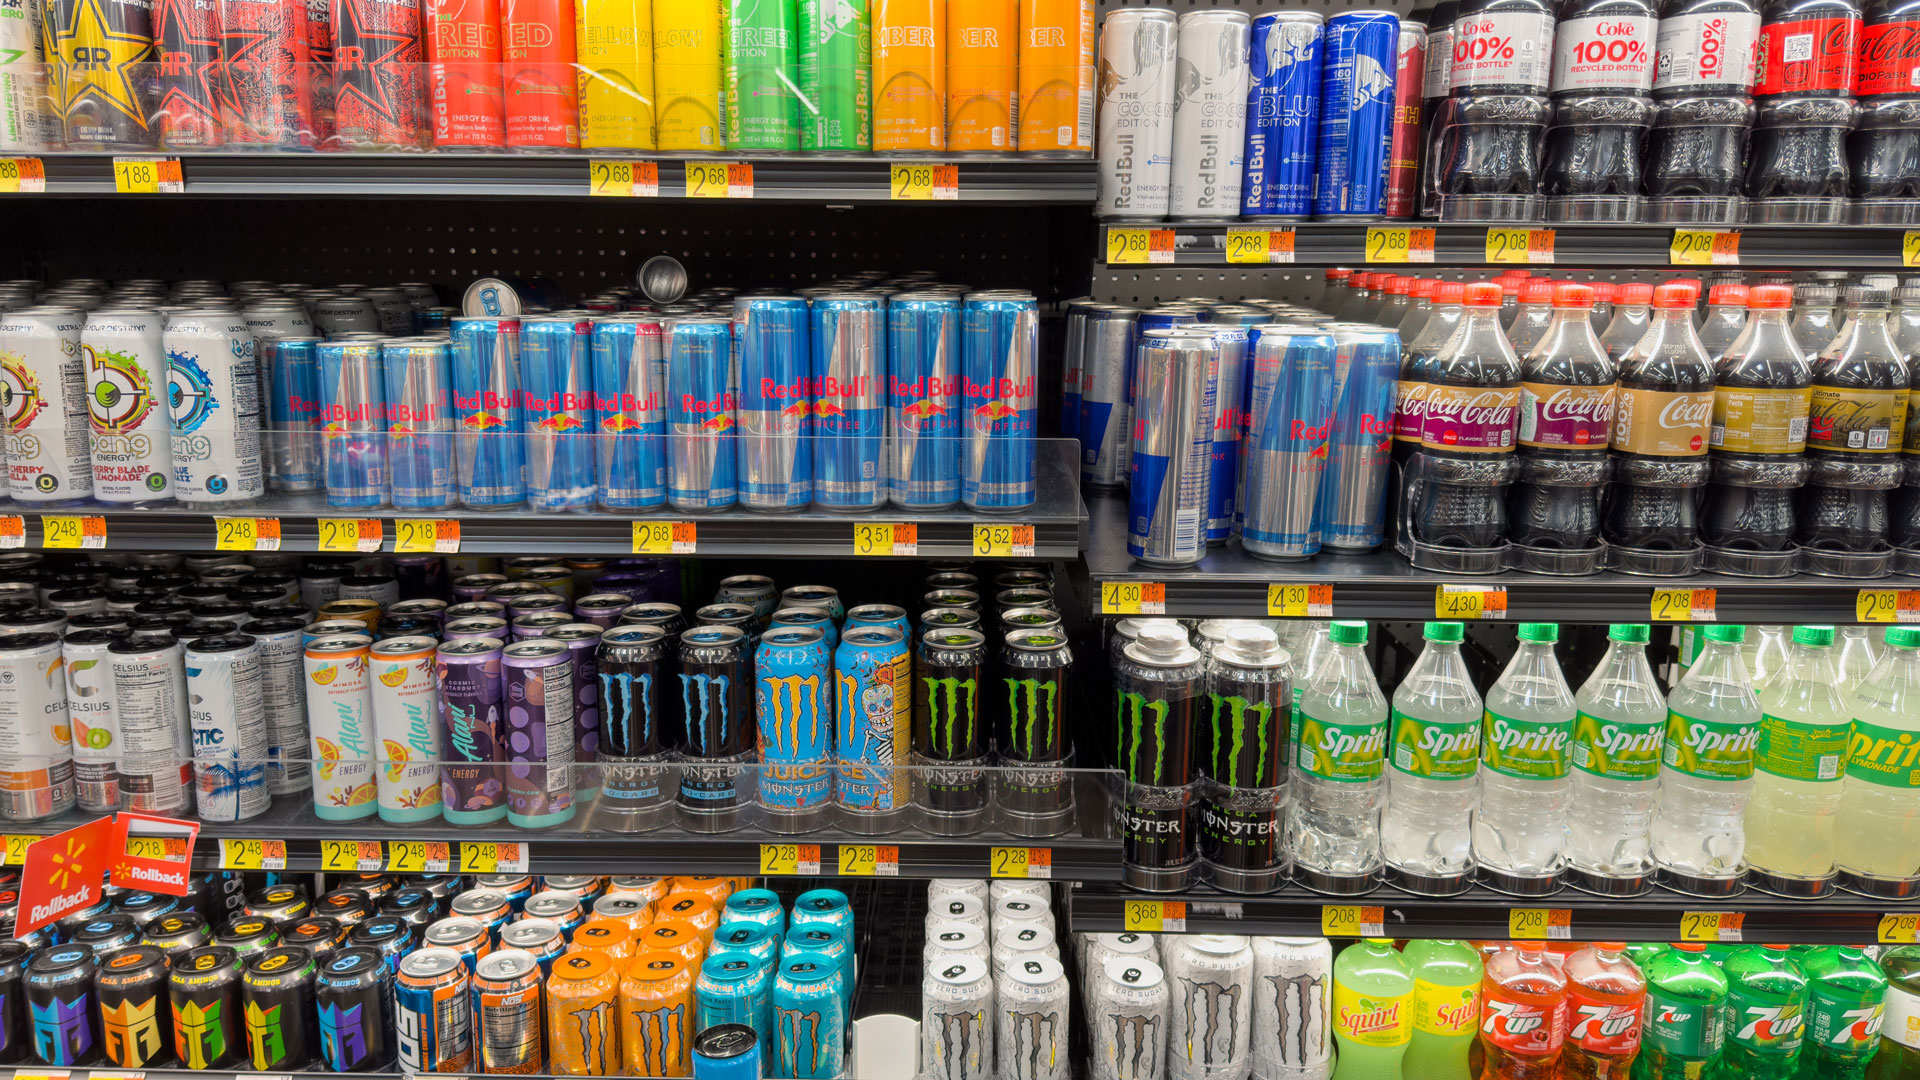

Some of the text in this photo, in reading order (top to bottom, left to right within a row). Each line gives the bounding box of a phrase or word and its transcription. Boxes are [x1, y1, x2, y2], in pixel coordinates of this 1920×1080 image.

[436, 23, 500, 49] RED
[1463, 21, 1494, 36] Coke
[1596, 21, 1635, 36] Coke
[728, 28, 793, 51] GREEN
[873, 27, 935, 47] MBER
[437, 49, 479, 58] EDITION
[729, 48, 766, 58] EDITION
[1453, 37, 1514, 64] 100%
[1573, 39, 1647, 64] 100%
[1699, 18, 1722, 79] 100%
[1333, 69, 1351, 78] 160
[1571, 63, 1614, 74] RECYCLED
[433, 64, 447, 100] Bull
[727, 66, 738, 103] Bull
[856, 69, 868, 105] Bull
[1259, 87, 1278, 95] THE
[1258, 95, 1319, 118] BLUE
[435, 103, 448, 140] Red
[452, 114, 480, 123] ENERGY
[528, 115, 550, 123] DRINK
[728, 106, 739, 143] Red
[1118, 119, 1158, 128] EDITION
[1201, 119, 1240, 129] EDITION
[1257, 118, 1300, 128] EDITION
[857, 108, 868, 146] Red
[1116, 134, 1134, 170] Bull
[1201, 135, 1218, 170] Bull
[1251, 134, 1265, 169] Bull
[1115, 173, 1132, 208] Red
[1137, 185, 1159, 193] ENERGY
[1198, 173, 1216, 208] Red
[1247, 172, 1263, 208] Red
[761, 376, 801, 400] Red
[826, 376, 866, 400] Bull
[890, 374, 961, 398] Red Bull
[963, 376, 1035, 400] Red Bull
[453, 389, 522, 410] Red Bull
[526, 391, 593, 412] Red Bull
[593, 391, 658, 412] Red Bull
[1729, 393, 1753, 402] Nutrition
[1813, 390, 1840, 399] Ultimate
[682, 393, 720, 413] Red
[1425, 388, 1516, 426] Coca-Cola
[1728, 400, 1743, 408] Facts
[334, 404, 364, 423] Bull
[399, 403, 434, 424] Bull
[1616, 392, 1630, 446] 100%
[1290, 419, 1329, 442] Red
[97, 453, 132, 465] ENERGY
[15, 464, 49, 478] CHERRY
[95, 472, 143, 483] LEMONADE
[118, 464, 151, 476] BLADE
[606, 647, 646, 657] TAURINE
[684, 648, 724, 658] TAURINE
[932, 652, 971, 662] TAURINE
[1012, 653, 1051, 664] TAURINE
[113, 663, 149, 673] CELSIUS
[333, 680, 362, 689] MIMOSA
[403, 681, 431, 690] MIMOSA
[545, 682, 566, 691] Calories
[69, 701, 110, 713] CELSIUS
[332, 700, 369, 760] Alani
[402, 701, 437, 761] Alani
[447, 701, 483, 763] Alani
[1490, 720, 1568, 752] Sprite
[1683, 723, 1760, 755] Sprite
[339, 764, 367, 777] ENERGY
[408, 764, 435, 778] ENERGY
[452, 768, 480, 779] ENERGY
[764, 759, 828, 781] JUICE
[1851, 757, 1901, 775] LYMONADE
[681, 779, 735, 790] ENERGY
[762, 779, 829, 797] MONSTER
[923, 782, 978, 793] ENERGY
[1003, 782, 1060, 794] ENERGY
[1213, 804, 1258, 819] MEGA
[1204, 827, 1267, 847] ENERGY
[132, 867, 184, 887] Rollback
[30, 885, 90, 925] Rollback
[122, 972, 153, 984] AMINOS
[188, 974, 218, 985] AMINOS
[253, 978, 280, 987] AMINOS
[331, 978, 360, 988] AMINOS
[568, 982, 592, 992] ZERO
[632, 982, 656, 992] ZERO
[795, 982, 829, 994] SUGAR
[935, 980, 988, 995] ZERO SUGAR
[1008, 982, 1062, 996] ZERO SUGAR
[1137, 986, 1163, 998] SUGAR
[501, 993, 525, 1007] NOS
[1338, 1000, 1401, 1037] Squirt
[1482, 1000, 1544, 1036] 7UP
[1510, 1010, 1545, 1020] CHERRY
[1607, 1008, 1638, 1021] CHERRY
[1656, 1004, 1692, 1023] 7UP
[1817, 1011, 1830, 1021] 240
[1569, 1005, 1636, 1041] 7UP
[1736, 1006, 1803, 1040] 7UP
